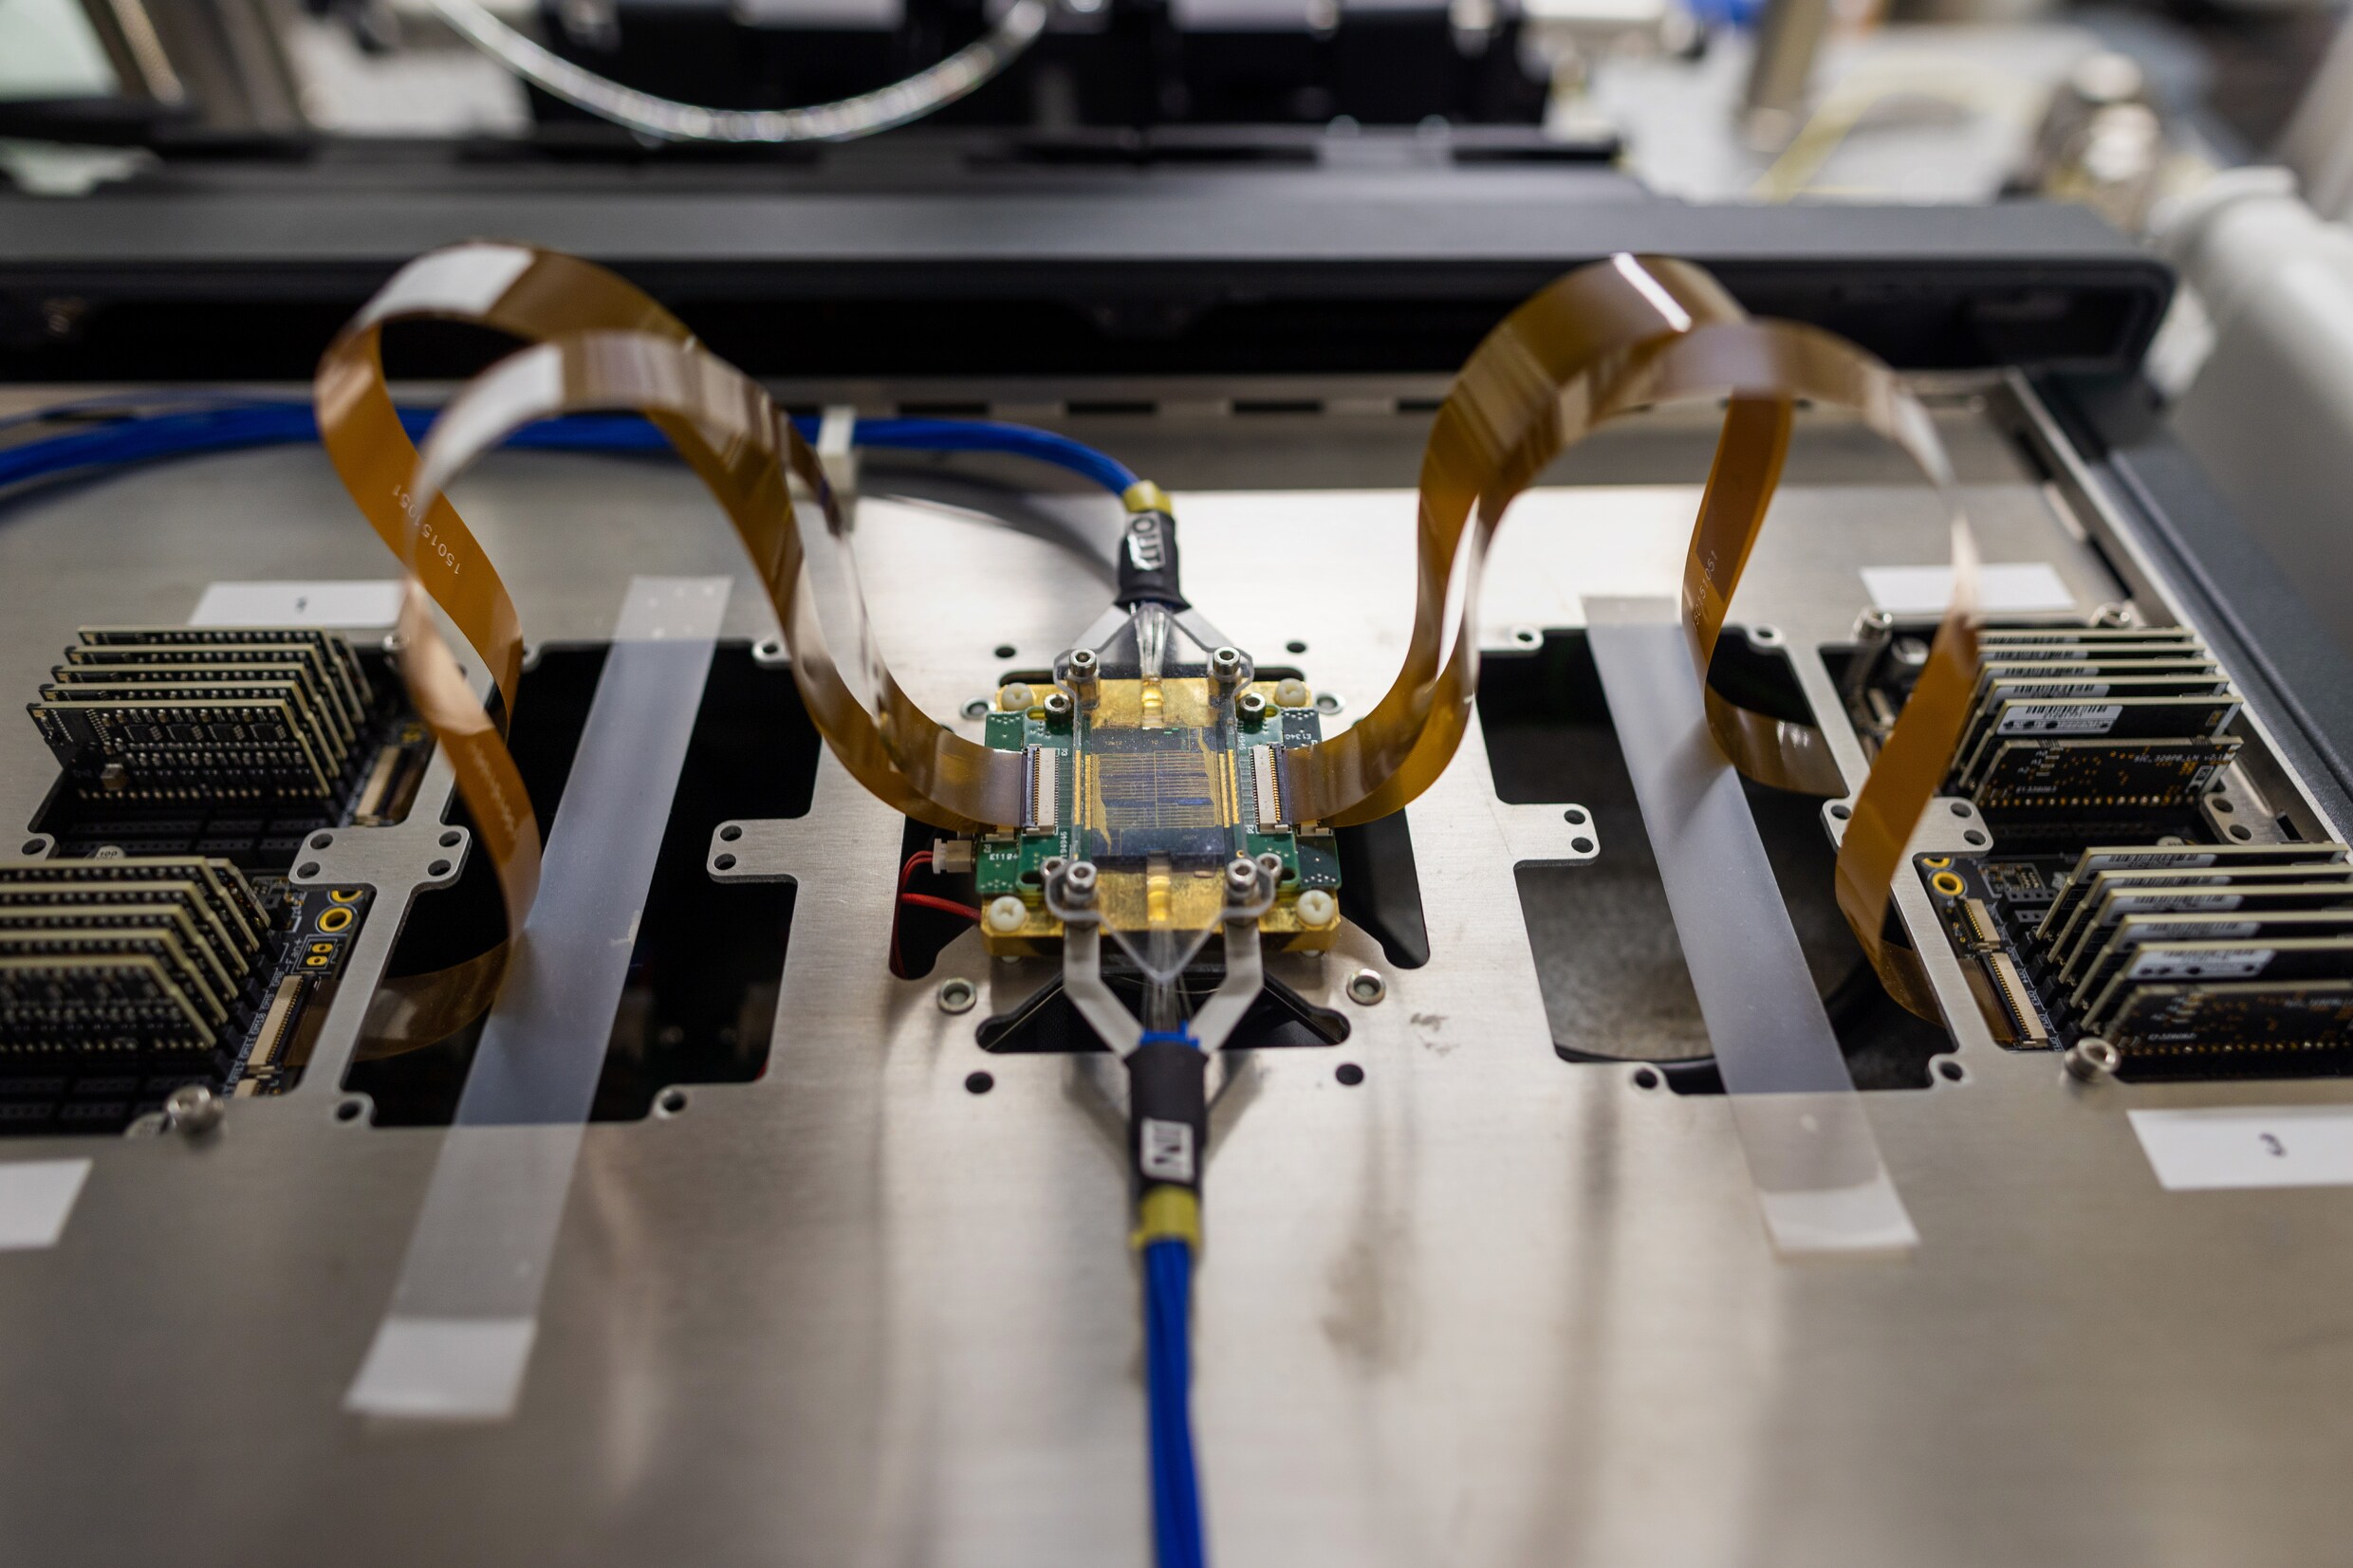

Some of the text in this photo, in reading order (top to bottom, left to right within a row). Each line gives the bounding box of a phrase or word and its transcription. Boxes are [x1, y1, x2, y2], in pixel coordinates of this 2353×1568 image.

[392, 484, 462, 576] 150151051
[1132, 516, 1161, 564] OUT
[1692, 550, 1718, 633] 150151051
[2016, 968, 2029, 984] DM4
[2027, 989, 2040, 1007] DM3
[2038, 1013, 2051, 1030] DM2
